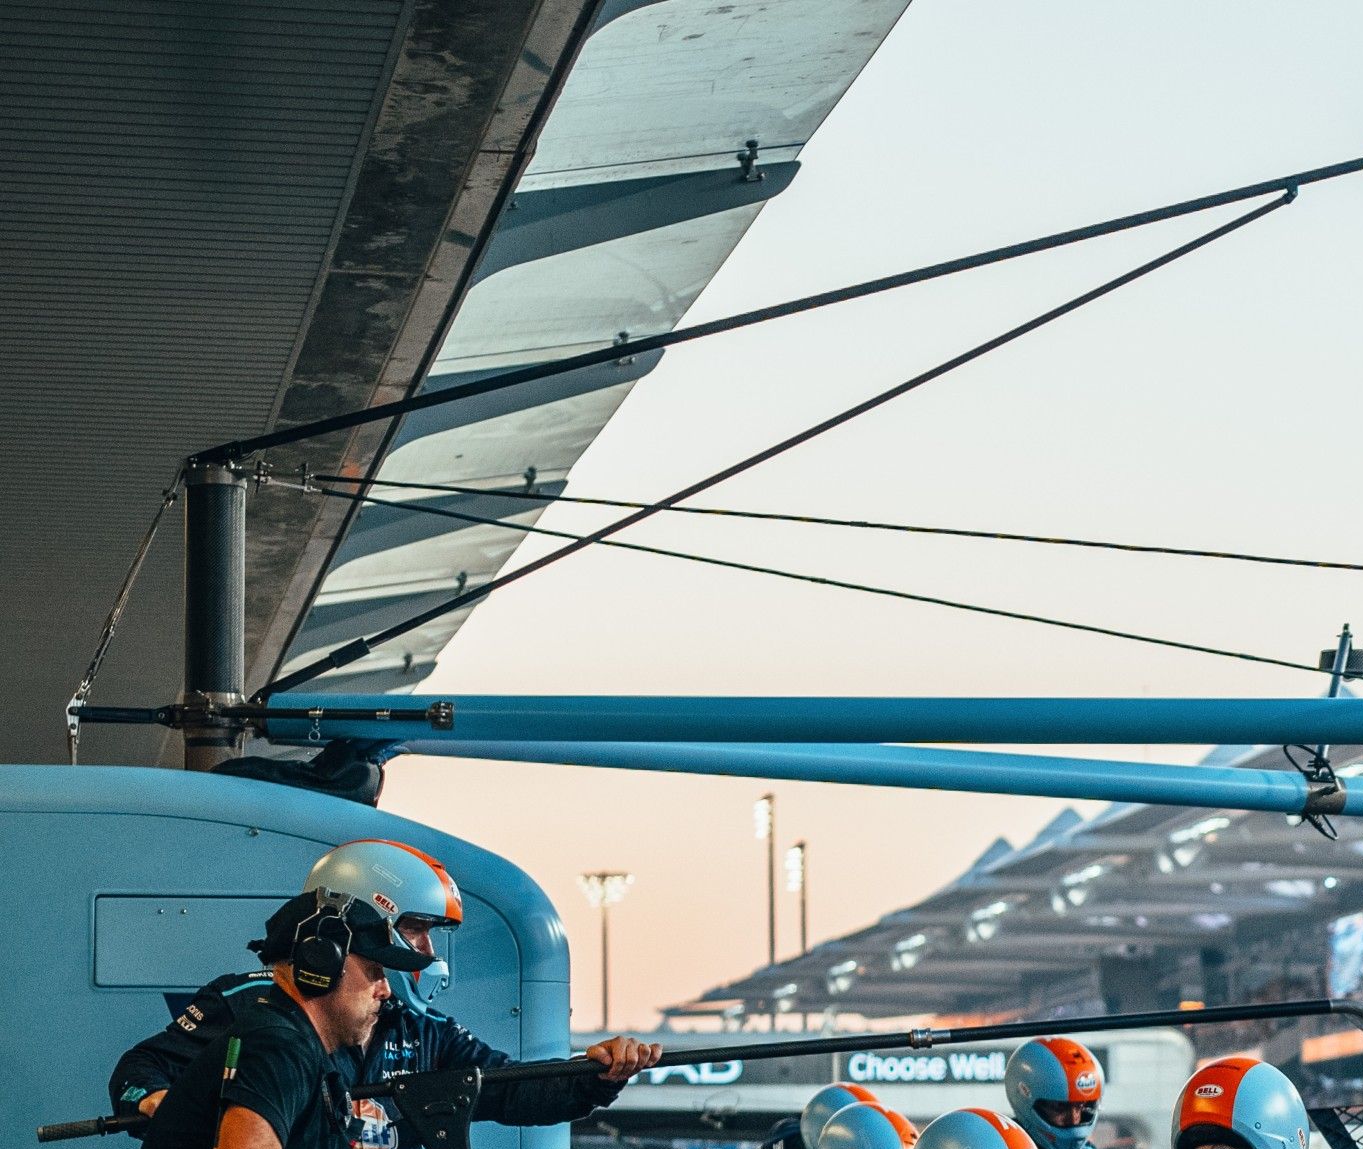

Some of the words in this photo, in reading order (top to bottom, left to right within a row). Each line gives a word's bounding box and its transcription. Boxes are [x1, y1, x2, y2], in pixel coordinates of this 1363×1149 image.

[373, 893, 397, 914] BELL
[849, 1052, 948, 1082] Choose
[1197, 1086, 1222, 1096] BELL
